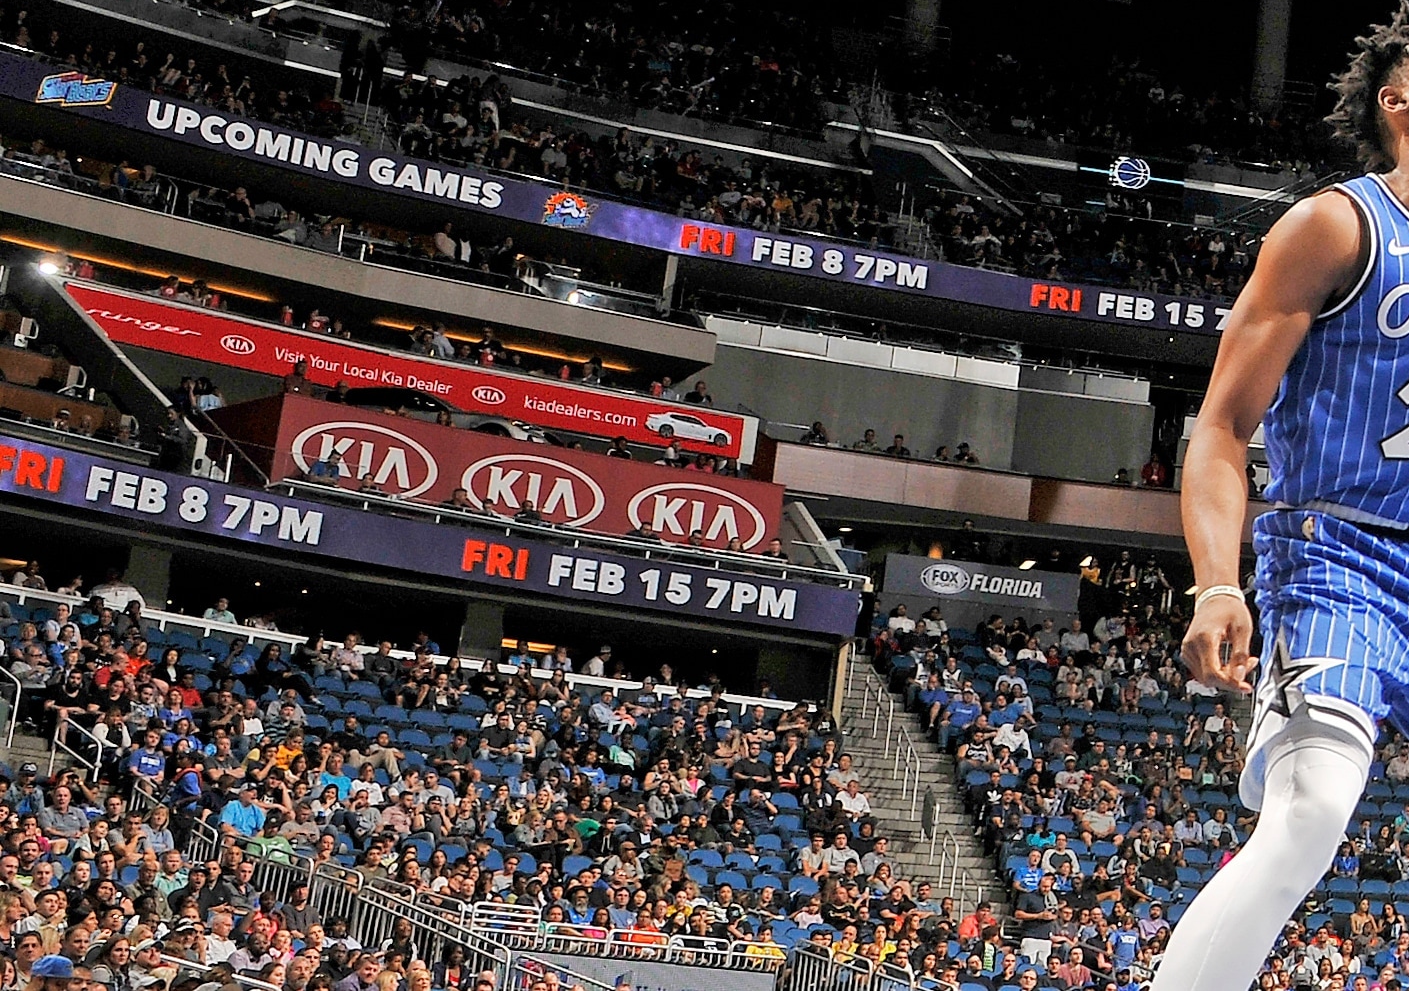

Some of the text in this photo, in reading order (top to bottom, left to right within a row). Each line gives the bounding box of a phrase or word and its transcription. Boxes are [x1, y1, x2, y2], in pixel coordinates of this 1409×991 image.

[146, 98, 505, 209] UPCOMING GAMES
[680, 223, 930, 291] FRI FEB 8 7PM
[1029, 283, 1083, 312] FRI
[1097, 291, 1156, 322] FEB
[1164, 301, 1205, 329] 15
[225, 338, 250, 352] KIA
[275, 346, 454, 396] Visit Your Local Kia Dealer
[476, 388, 502, 401] KIA
[523, 394, 638, 428] kiadealers.com
[318, 432, 411, 491] KIA
[0, 443, 324, 546] FRI FEB 8 7PM
[487, 465, 580, 519] KIA
[652, 493, 737, 543] KIA
[461, 538, 798, 621] FRI FEB 15 7PM
[931, 569, 959, 584] FOX
[969, 573, 1043, 599] FLORIDA
